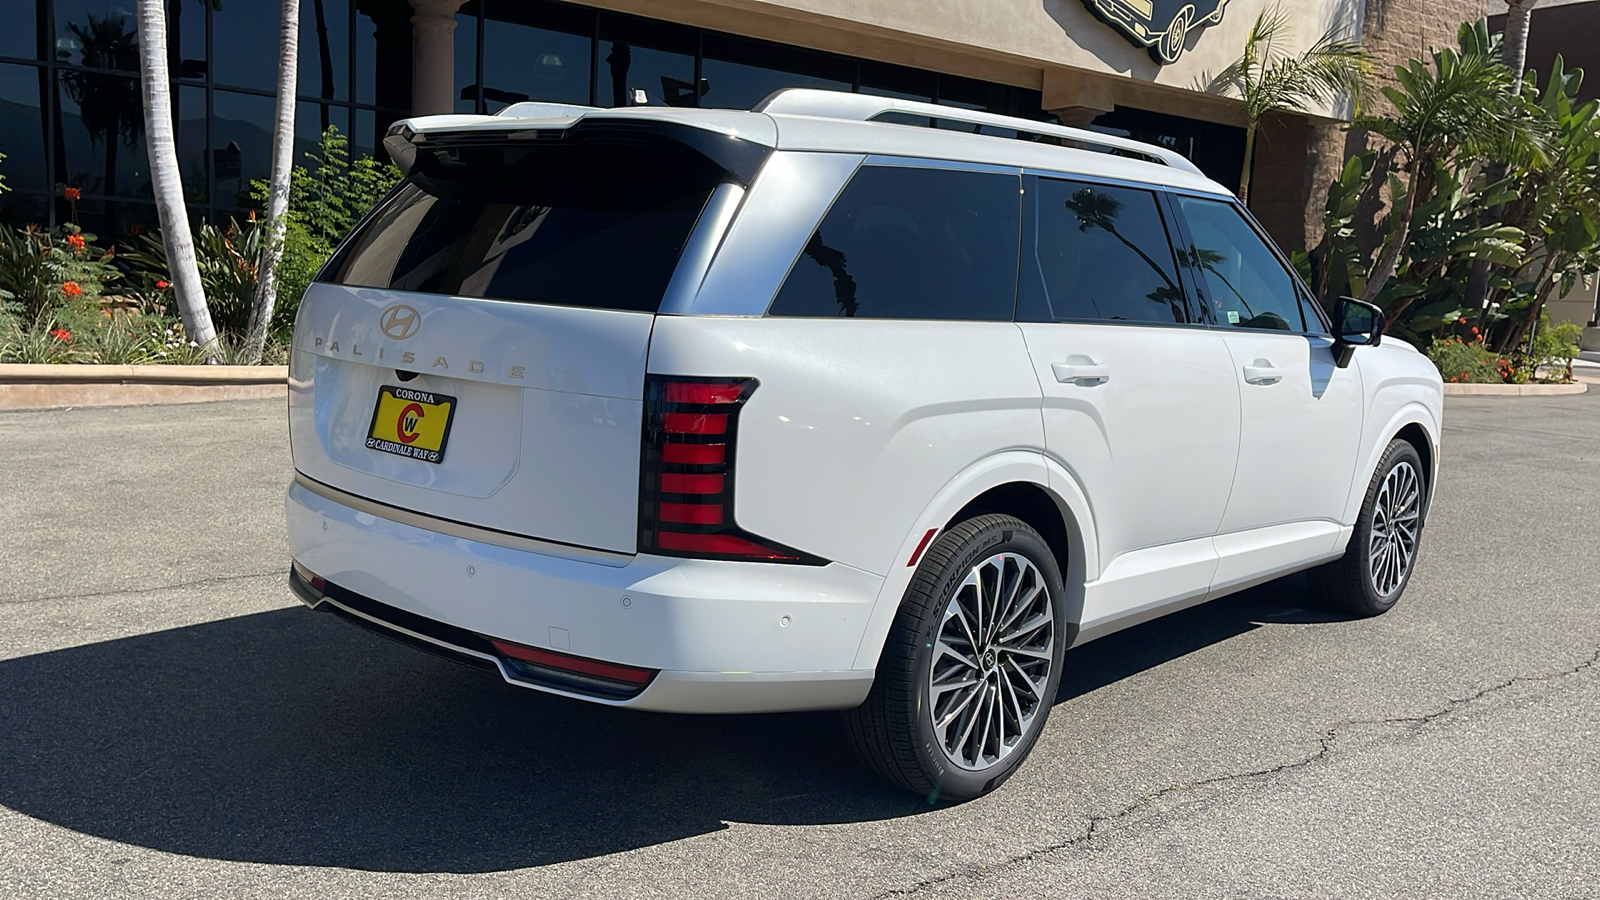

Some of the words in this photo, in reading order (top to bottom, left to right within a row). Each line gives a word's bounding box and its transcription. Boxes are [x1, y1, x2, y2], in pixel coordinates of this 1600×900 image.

[314, 336, 526, 380] PALISADE
[395, 388, 435, 404] CORONA
[375, 439, 413, 457] CARDINALE
[413, 447, 430, 460] WAY
[932, 546, 980, 618] SCORPION
